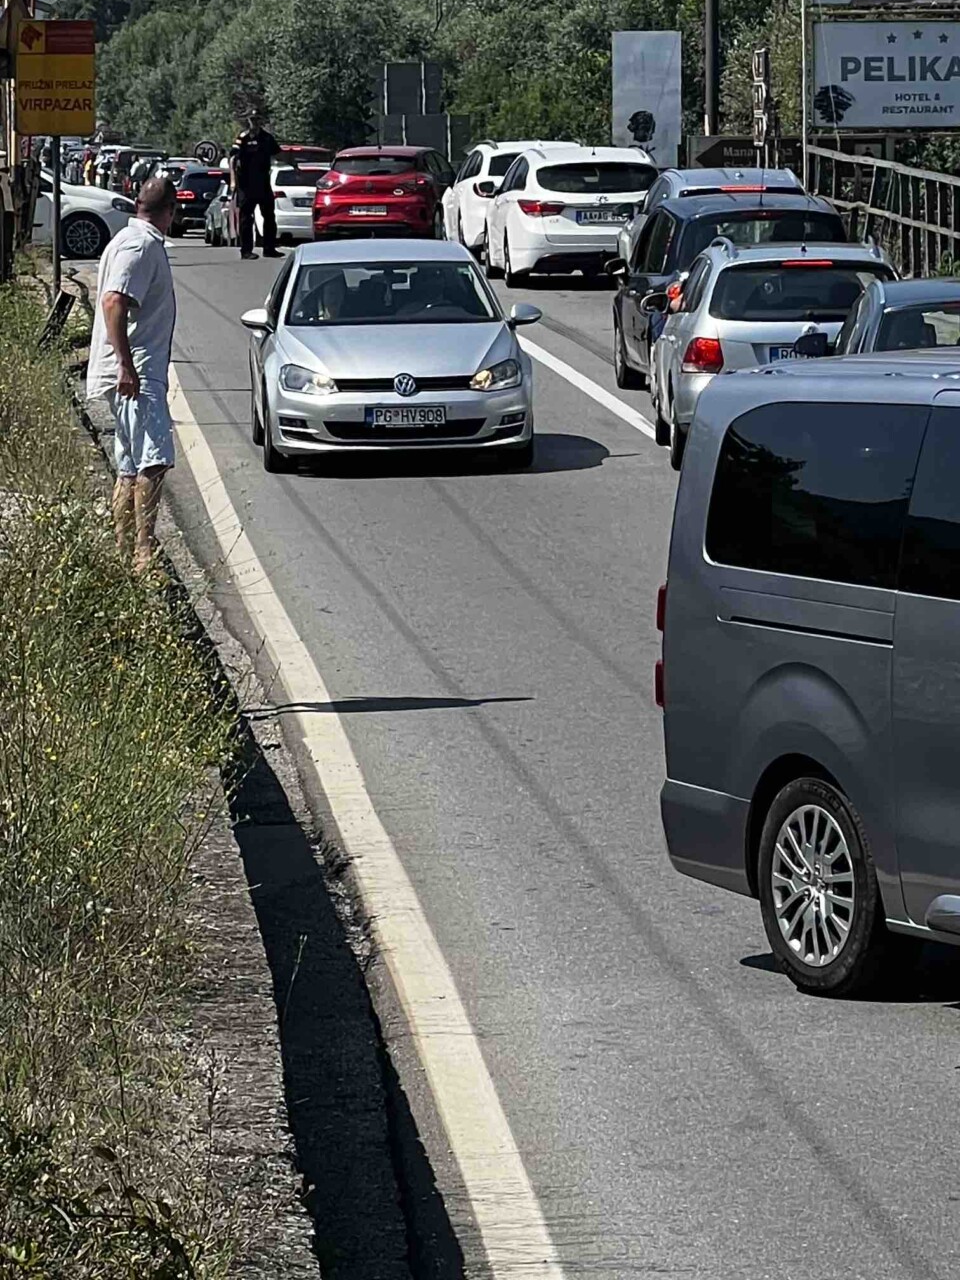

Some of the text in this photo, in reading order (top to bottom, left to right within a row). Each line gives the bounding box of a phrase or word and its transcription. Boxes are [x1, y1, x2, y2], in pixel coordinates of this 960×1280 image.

[19, 79, 93, 90] PRUŽNI PRELAZ
[895, 93, 941, 101] HOTEL &
[19, 98, 93, 111] VIRPAZAR
[881, 105, 955, 114] RESTAURANT
[375, 408, 443, 423] PG HV908
